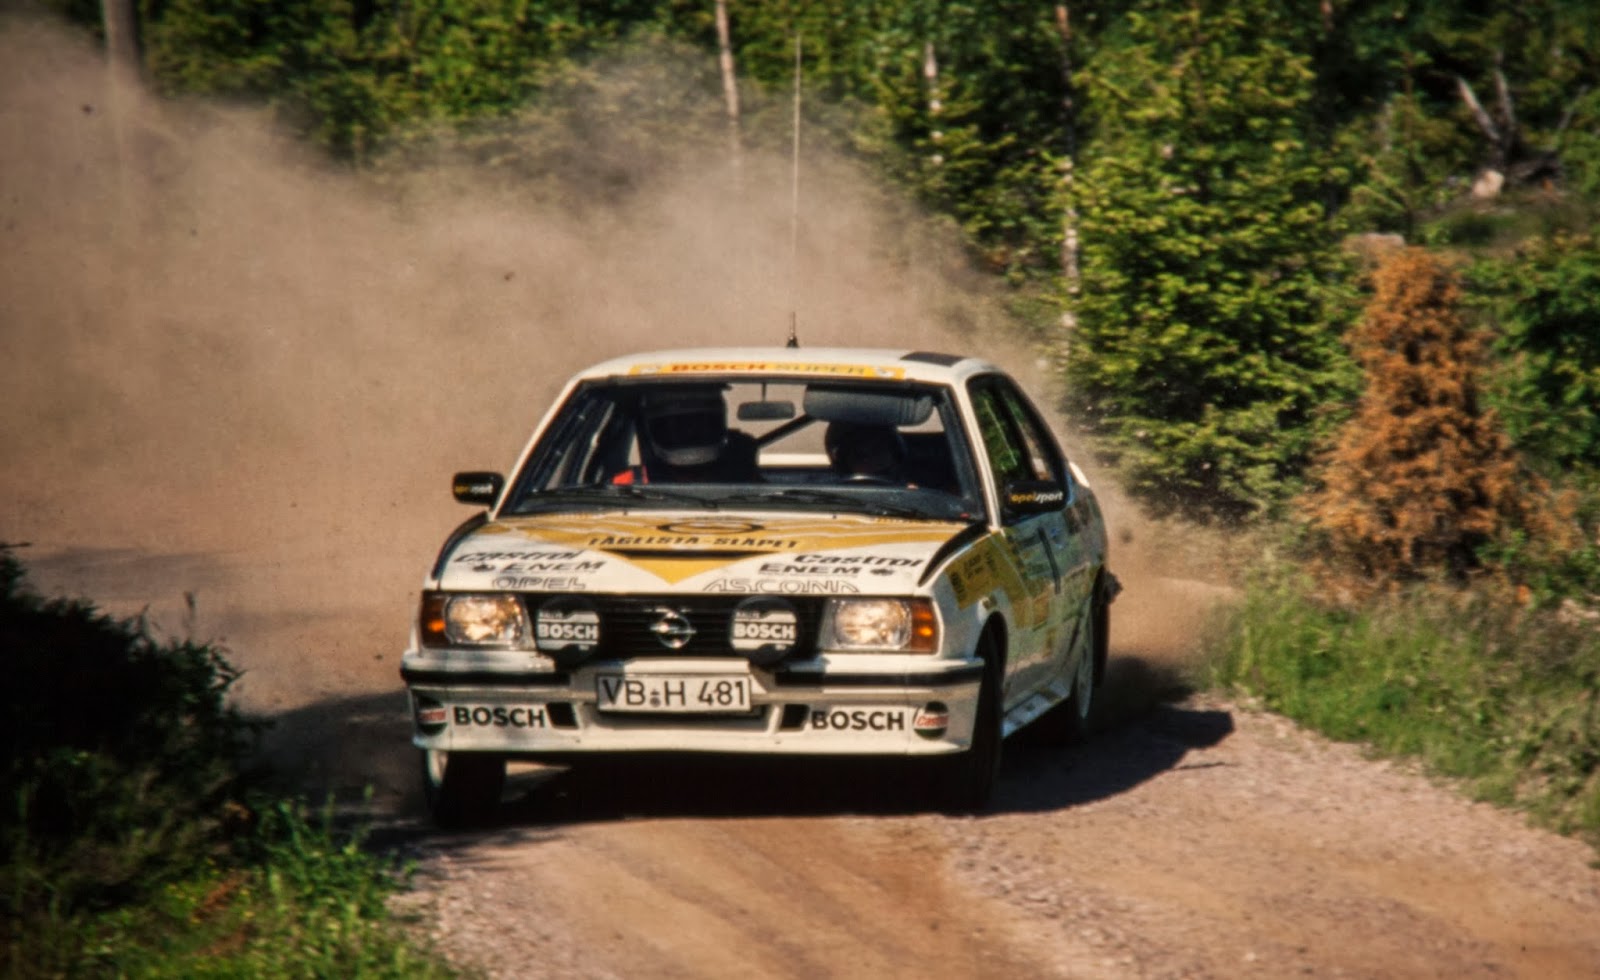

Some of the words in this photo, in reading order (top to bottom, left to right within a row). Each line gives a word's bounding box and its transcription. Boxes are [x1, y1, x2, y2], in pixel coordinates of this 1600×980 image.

[671, 363, 766, 373] BOSCH
[502, 560, 607, 573] ENEM
[759, 562, 862, 575] ENEM
[794, 554, 925, 567] Castrol
[491, 575, 587, 590] OPEL
[702, 577, 861, 593] ASCONA
[538, 623, 598, 640] BOSCH
[734, 622, 796, 640] BOSCH
[602, 678, 646, 706] VB
[664, 680, 687, 706] H
[697, 680, 745, 706] 481
[453, 705, 545, 728] BOSCH
[810, 709, 905, 731] BOSCH
